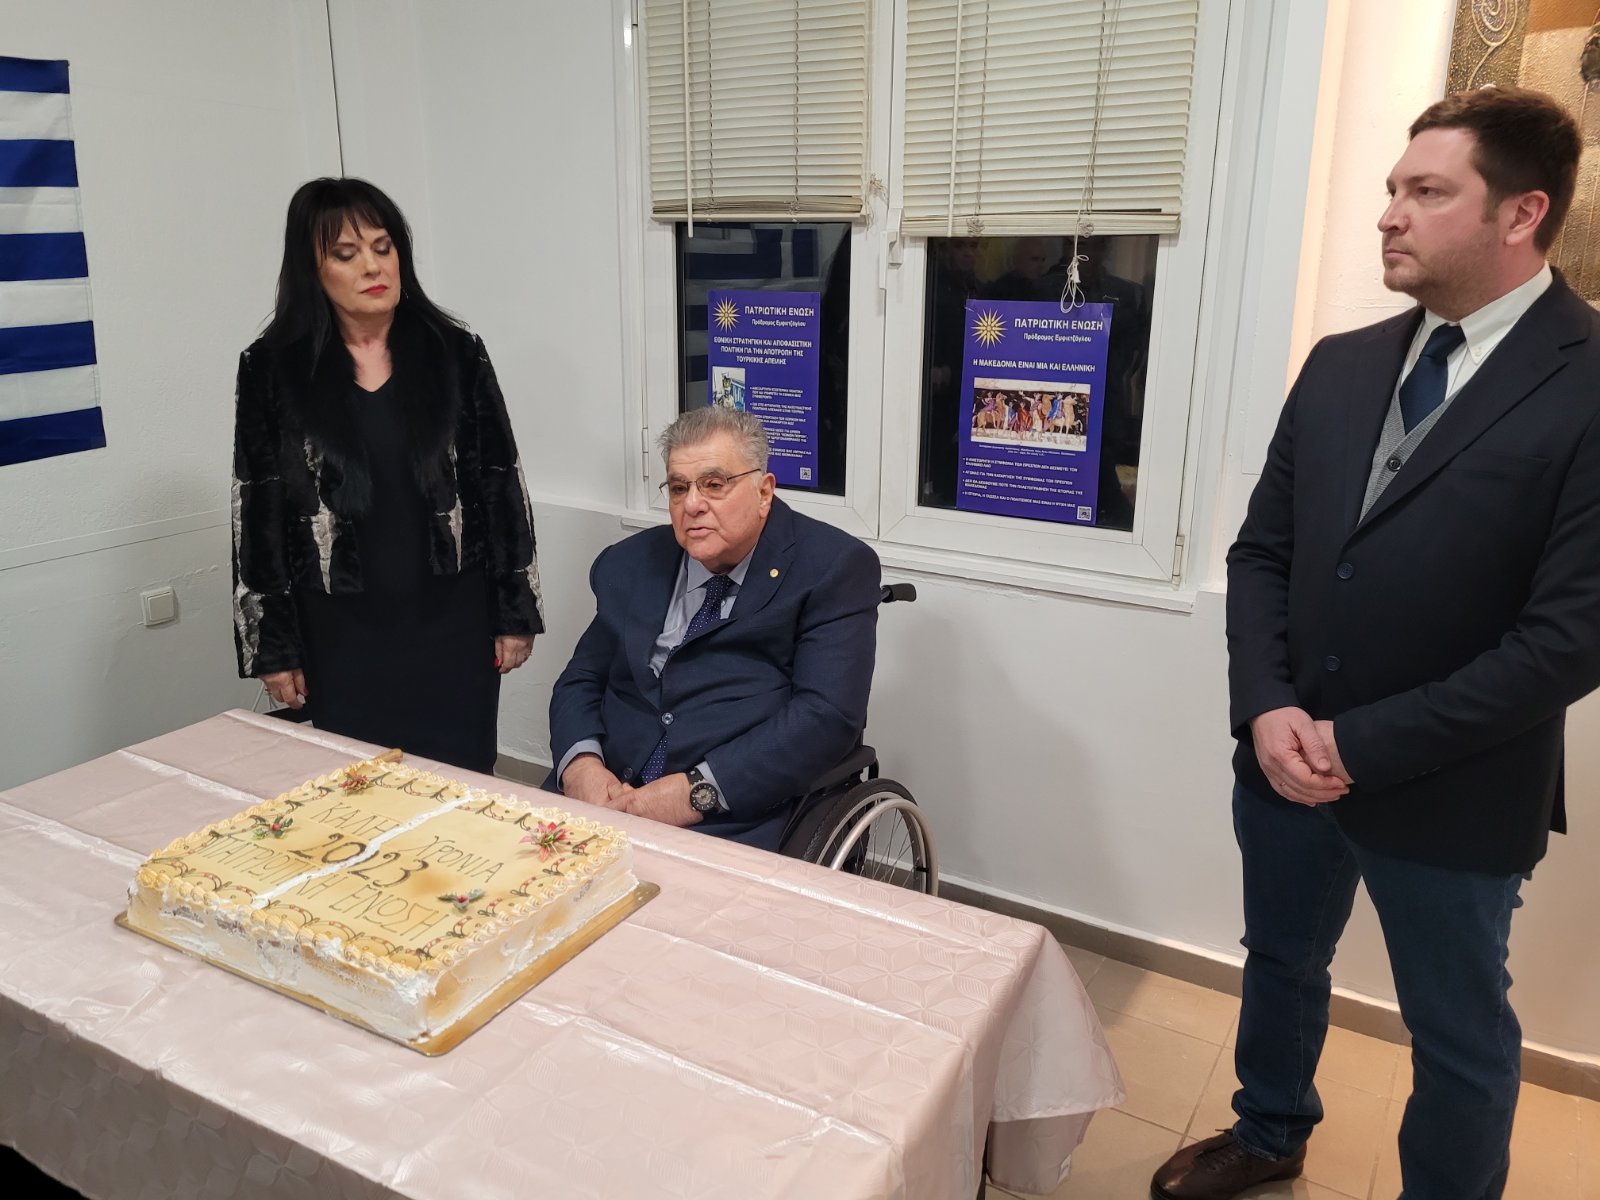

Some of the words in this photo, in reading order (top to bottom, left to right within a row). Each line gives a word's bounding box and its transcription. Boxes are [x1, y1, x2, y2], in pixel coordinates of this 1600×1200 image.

[744, 306, 787, 316] ΠΑΤΡΙΩΤΙΚΗ
[789, 308, 814, 316] ΕΝΩΣΗ
[1014, 318, 1069, 329] ΠΑΤΡΙΩΤΙΚΗ
[1072, 320, 1104, 331] ΕΝΩΣΗ
[714, 336, 732, 344] ΕΘΝΙΚΗ
[733, 338, 763, 346] ΣΤΡΑΤΗΓΙΚΗ
[773, 340, 812, 348] ΑΠΟΦΑΣΙΣΤΙΚΗ
[1024, 333, 1054, 342] Πρόδρομος
[721, 346, 744, 354] ΠΟΛΙΤΙΚΗ
[763, 348, 793, 356] ΑΠΟΤΡΟΠΗ
[979, 359, 1017, 368] ΜΑΚΕΔΟΝΙΑ
[1018, 361, 1035, 369] ΕΙΝΑΙ
[1036, 362, 1048, 370] ΜΙΑ
[1062, 363, 1096, 372] ΕΛΛΗΝΙΚΗ
[310, 801, 399, 841] ΚΑΛΗ
[399, 835, 504, 883] ΧΡΟΝΙΑ
[286, 832, 429, 888] 2023
[328, 884, 450, 941] ΕΝΩΣΗ
